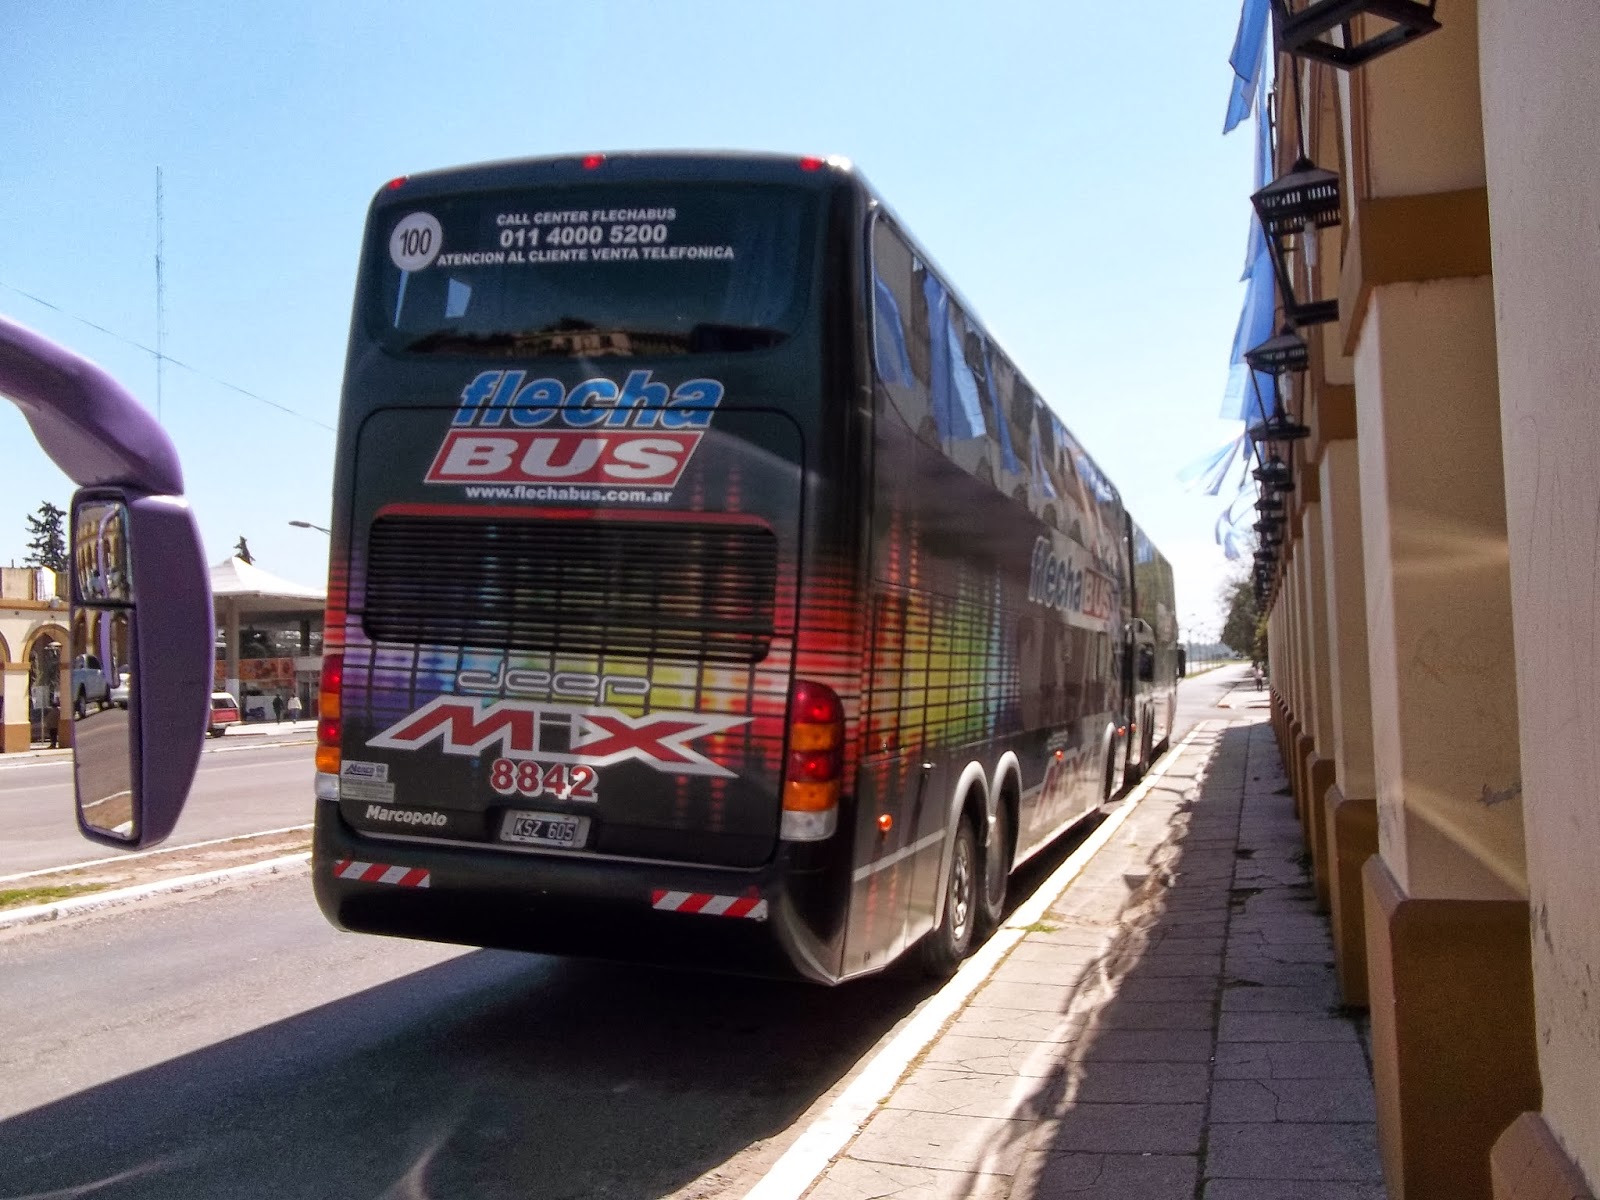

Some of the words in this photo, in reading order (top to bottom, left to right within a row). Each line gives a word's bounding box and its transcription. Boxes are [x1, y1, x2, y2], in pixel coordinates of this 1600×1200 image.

[496, 213, 531, 226] CALL
[533, 210, 589, 225] CENTER
[591, 207, 677, 223] FLECHABUS
[401, 227, 432, 257] 100
[500, 229, 540, 248] 011
[546, 226, 604, 246] 4000
[609, 224, 668, 243] 5200
[436, 251, 505, 268] ATENCION
[507, 250, 526, 264] AL
[528, 249, 588, 263] CLIENTE
[590, 247, 640, 261] VENTA
[642, 245, 736, 260] TELEFONICA
[451, 369, 726, 428] flecha
[439, 437, 685, 480] BUS
[465, 485, 674, 504] www.flechabus.com.ar
[490, 758, 599, 803] 8842
[366, 804, 448, 826] Marcopolo
[514, 818, 542, 837] KSZ
[547, 822, 575, 841] 605
